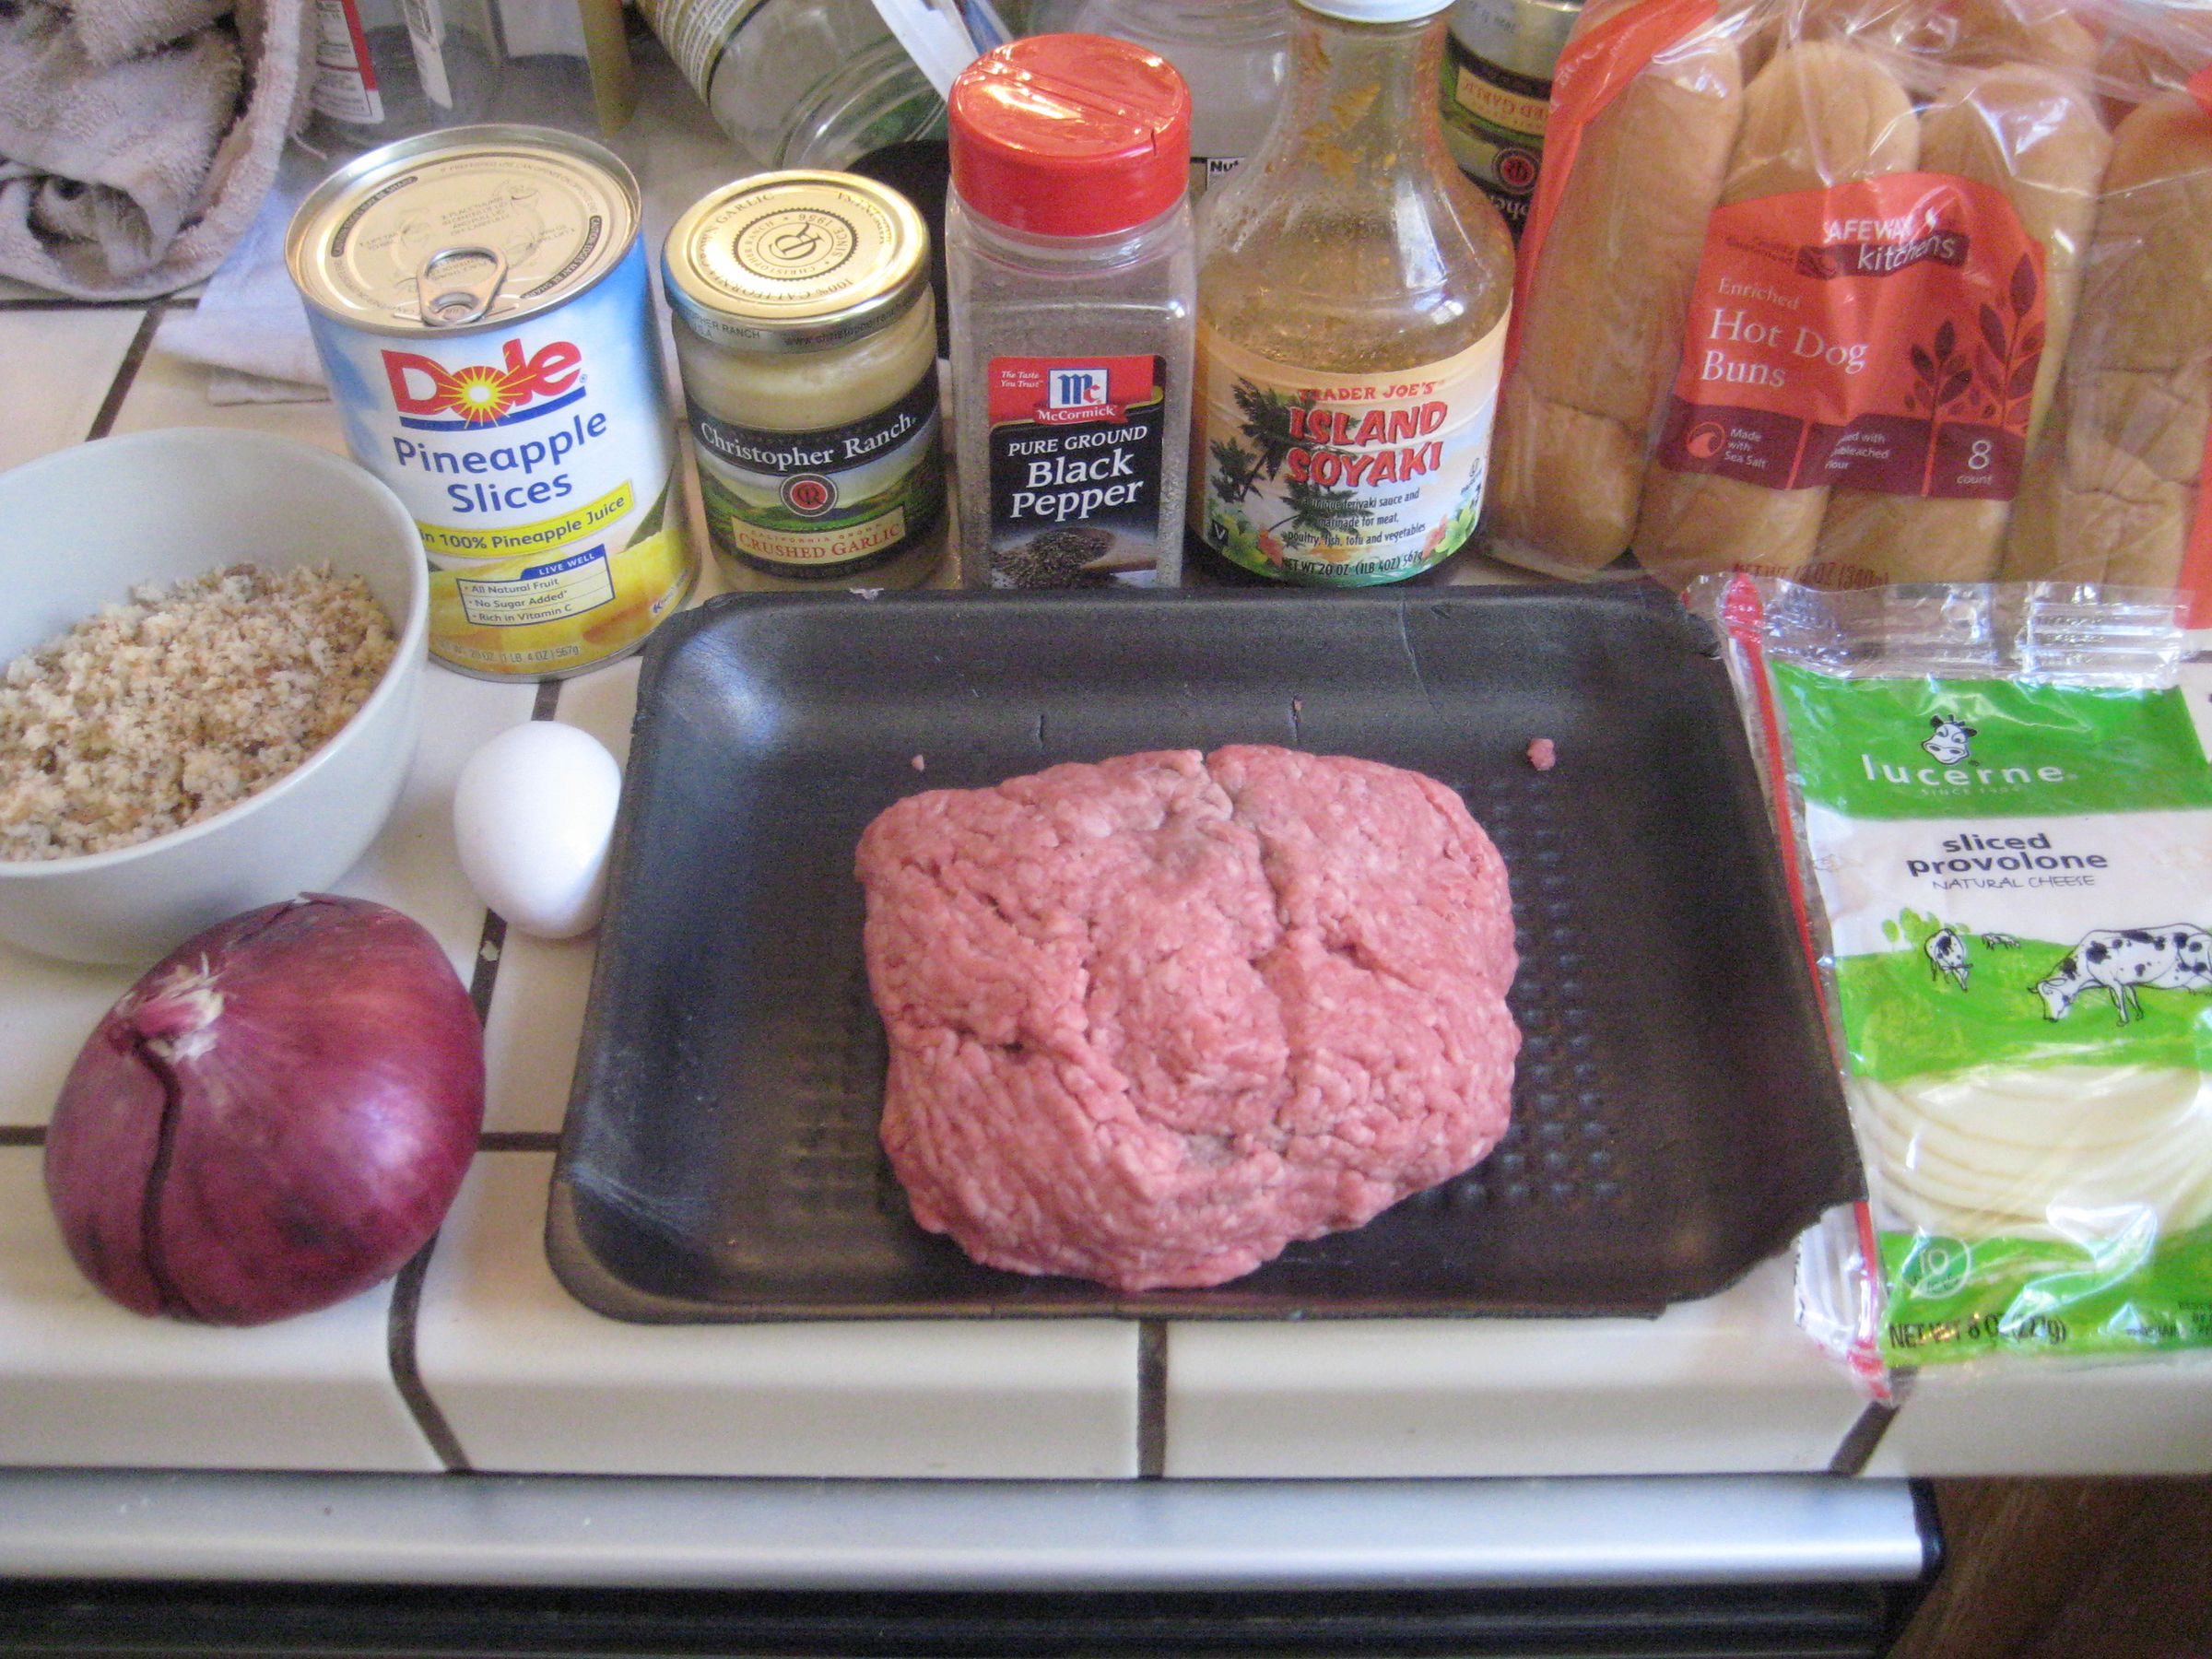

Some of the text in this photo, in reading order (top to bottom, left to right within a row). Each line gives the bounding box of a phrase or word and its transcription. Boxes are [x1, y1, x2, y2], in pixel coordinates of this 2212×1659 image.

[716, 192, 775, 224] GARLIC
[798, 213, 833, 228] 1956
[832, 227, 848, 257] SINCE
[1857, 235, 1956, 271] kitchens
[815, 278, 853, 296] 100%
[1718, 276, 1800, 310] Enriched
[1707, 307, 1868, 375] Hot Dog
[382, 338, 582, 423] Dole
[1001, 371, 1040, 379] The Taste
[1699, 349, 1786, 388] Buns
[1000, 379, 1041, 388] You Trust
[1298, 381, 1438, 402] TRADER JOE'S
[1037, 406, 1117, 422] McCormick
[1289, 401, 1448, 447] ISLAND
[393, 412, 608, 475] Pineapple
[700, 413, 912, 472] Christopher Ranch
[1007, 426, 1147, 457] PURE GROUND
[1727, 440, 1751, 453] with
[1729, 428, 1762, 442] Made
[1724, 451, 1745, 462] Sea
[1832, 445, 1890, 459] bleached
[1967, 440, 1992, 470] 8
[1026, 448, 1135, 488] Black
[1286, 441, 1444, 488] SOYAKI
[1956, 474, 1994, 486] count
[447, 474, 572, 513] Slices
[1009, 480, 1145, 523] Pepper
[1343, 497, 1378, 510] teriyaki
[1379, 496, 1402, 507] sauce
[1404, 488, 1420, 504] and
[420, 495, 625, 549] in 100% Pineapple Juice
[1319, 517, 1359, 528] marinade
[1361, 516, 1374, 527] for
[1346, 534, 1364, 545] tofu
[1366, 531, 1382, 544] and
[1384, 523, 1426, 543] vegetables
[739, 523, 900, 559] CRUSHED GARLIC
[538, 552, 595, 576] LIVE WELL
[1301, 559, 1315, 574] WT
[1319, 562, 1333, 576] 20
[1336, 563, 1349, 576] OZ
[471, 578, 560, 594] All Natural Fruit
[474, 599, 491, 608] No
[493, 599, 525, 610] Sugar
[478, 604, 572, 622] Rich in Vitamin C
[1861, 753, 2065, 786] lucerne
[1942, 832, 2052, 853] sliced
[1906, 852, 2108, 877] provolone
[1932, 875, 2095, 890] NATURAL CHEESE
